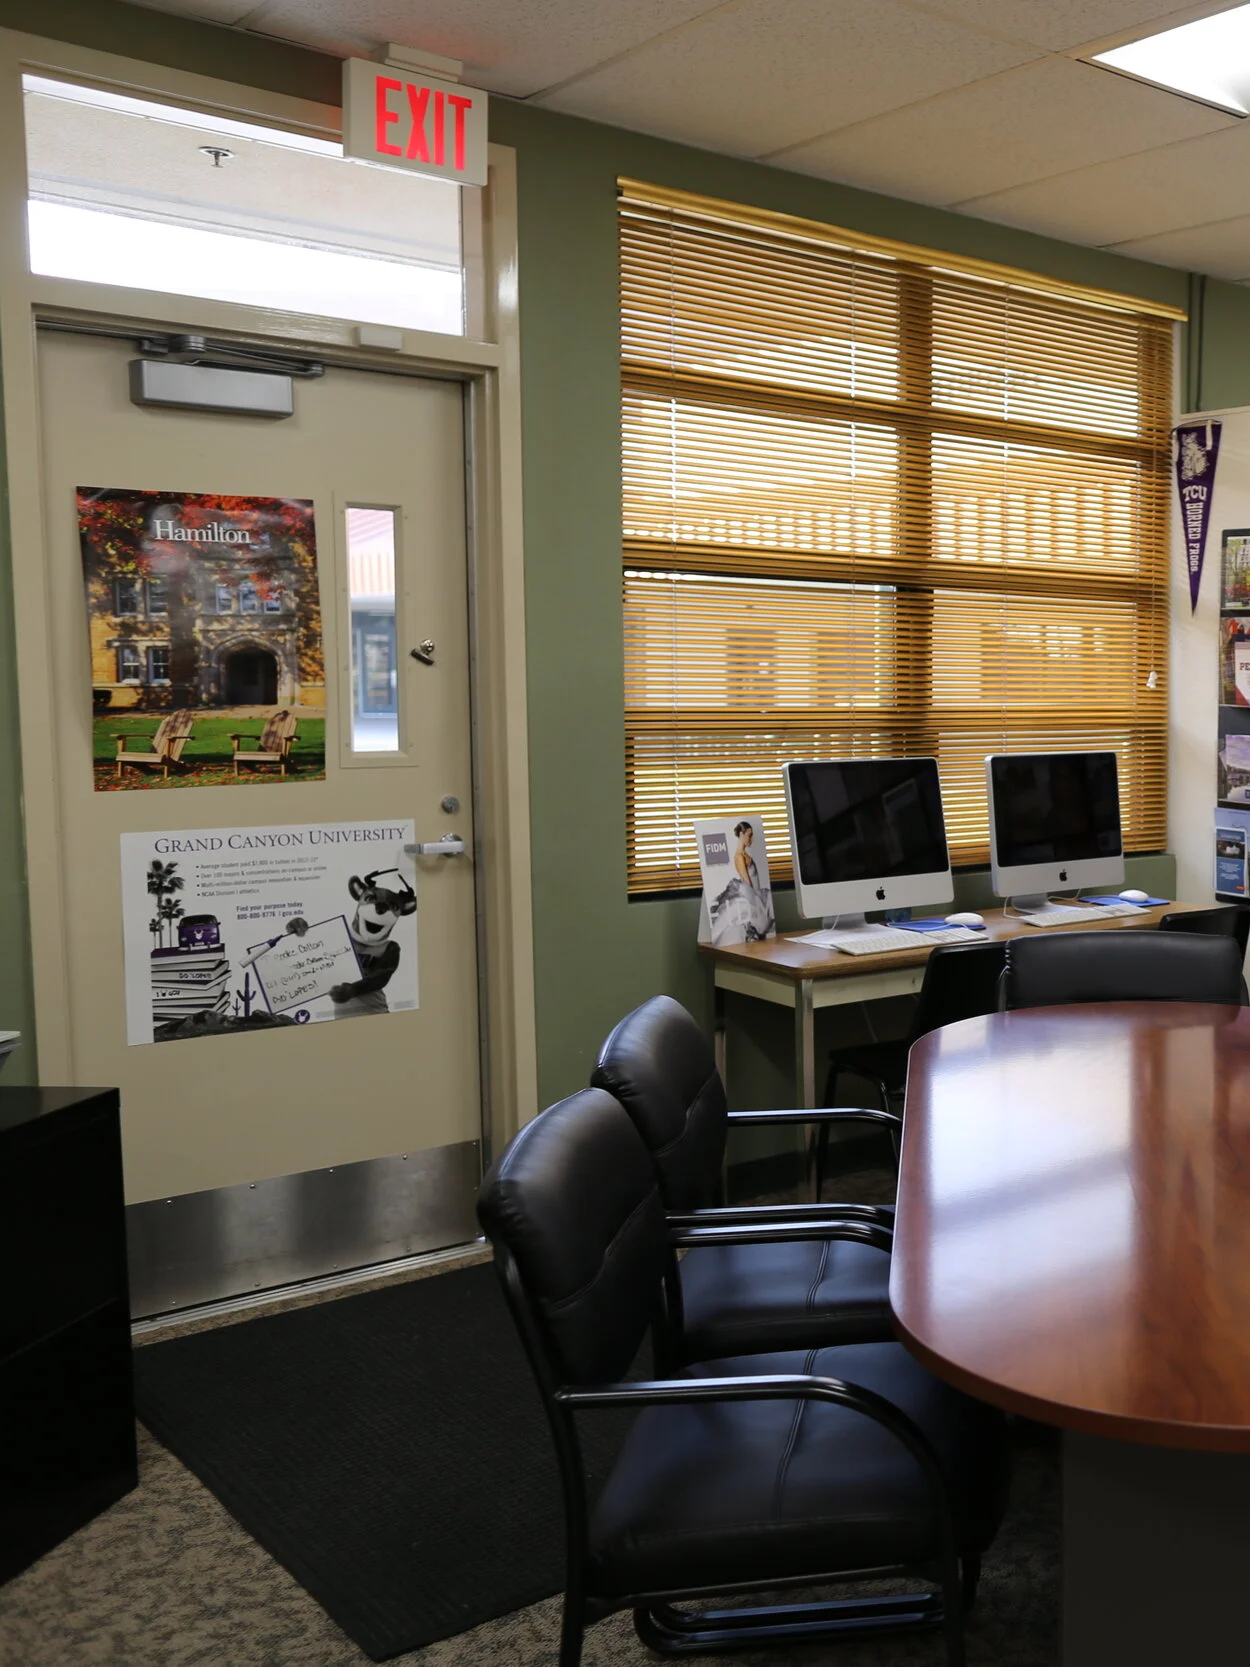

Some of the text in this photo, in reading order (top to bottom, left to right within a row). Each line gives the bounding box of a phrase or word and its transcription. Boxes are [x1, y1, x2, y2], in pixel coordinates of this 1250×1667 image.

[375, 75, 472, 171] EXIT
[1182, 485, 1207, 502] TCU
[153, 519, 251, 545] Hamilton
[1186, 502, 1204, 540] HORNED
[154, 827, 407, 854] GRAND CANYON UNIVERSITY
[705, 843, 727, 854] FIDM
[264, 903, 286, 911] purpose
